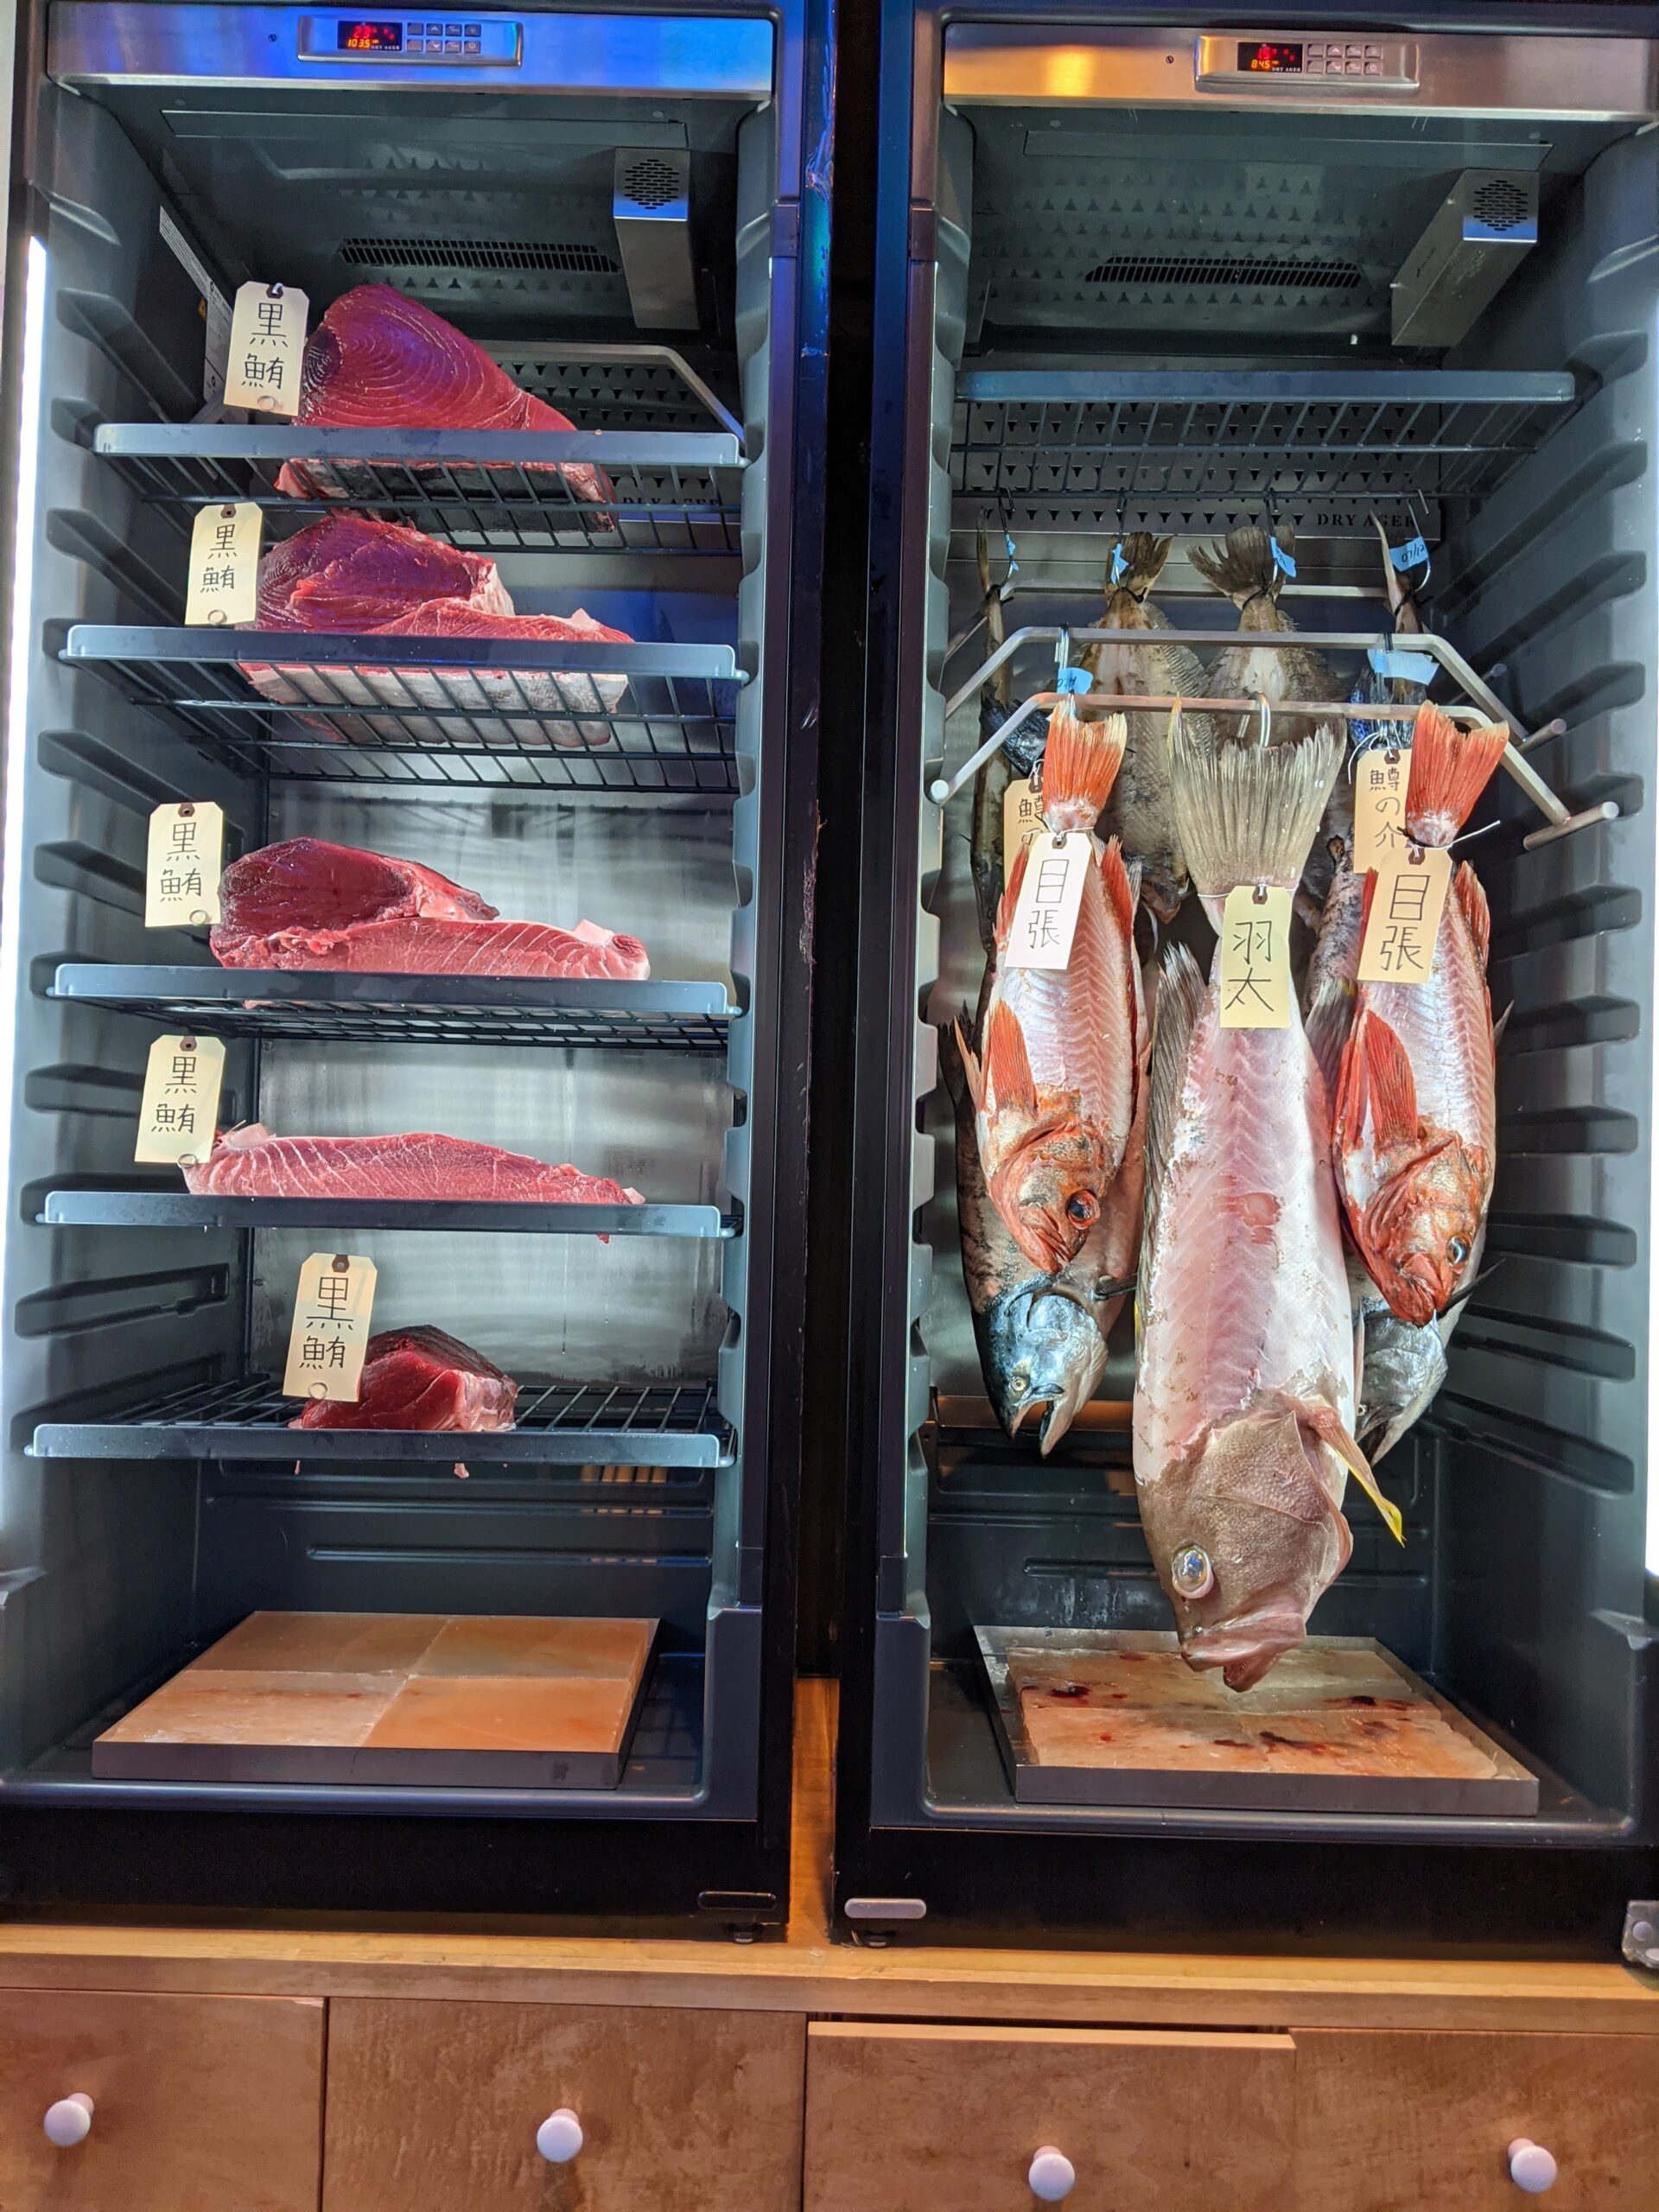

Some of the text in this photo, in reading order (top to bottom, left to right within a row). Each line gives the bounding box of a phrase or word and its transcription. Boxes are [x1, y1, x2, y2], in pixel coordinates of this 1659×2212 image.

[240, 302, 289, 390] 黒鮪
[200, 523, 238, 594] 黒鮪
[1317, 513, 1357, 526] DRY
[159, 821, 202, 903] 黒鮪
[1027, 858, 1070, 950] 目張
[1224, 919, 1275, 1013] 羽太
[1379, 874, 1432, 971] 目張
[150, 1055, 198, 1135] 黒鮪
[298, 1276, 354, 1370] 黒鮪
